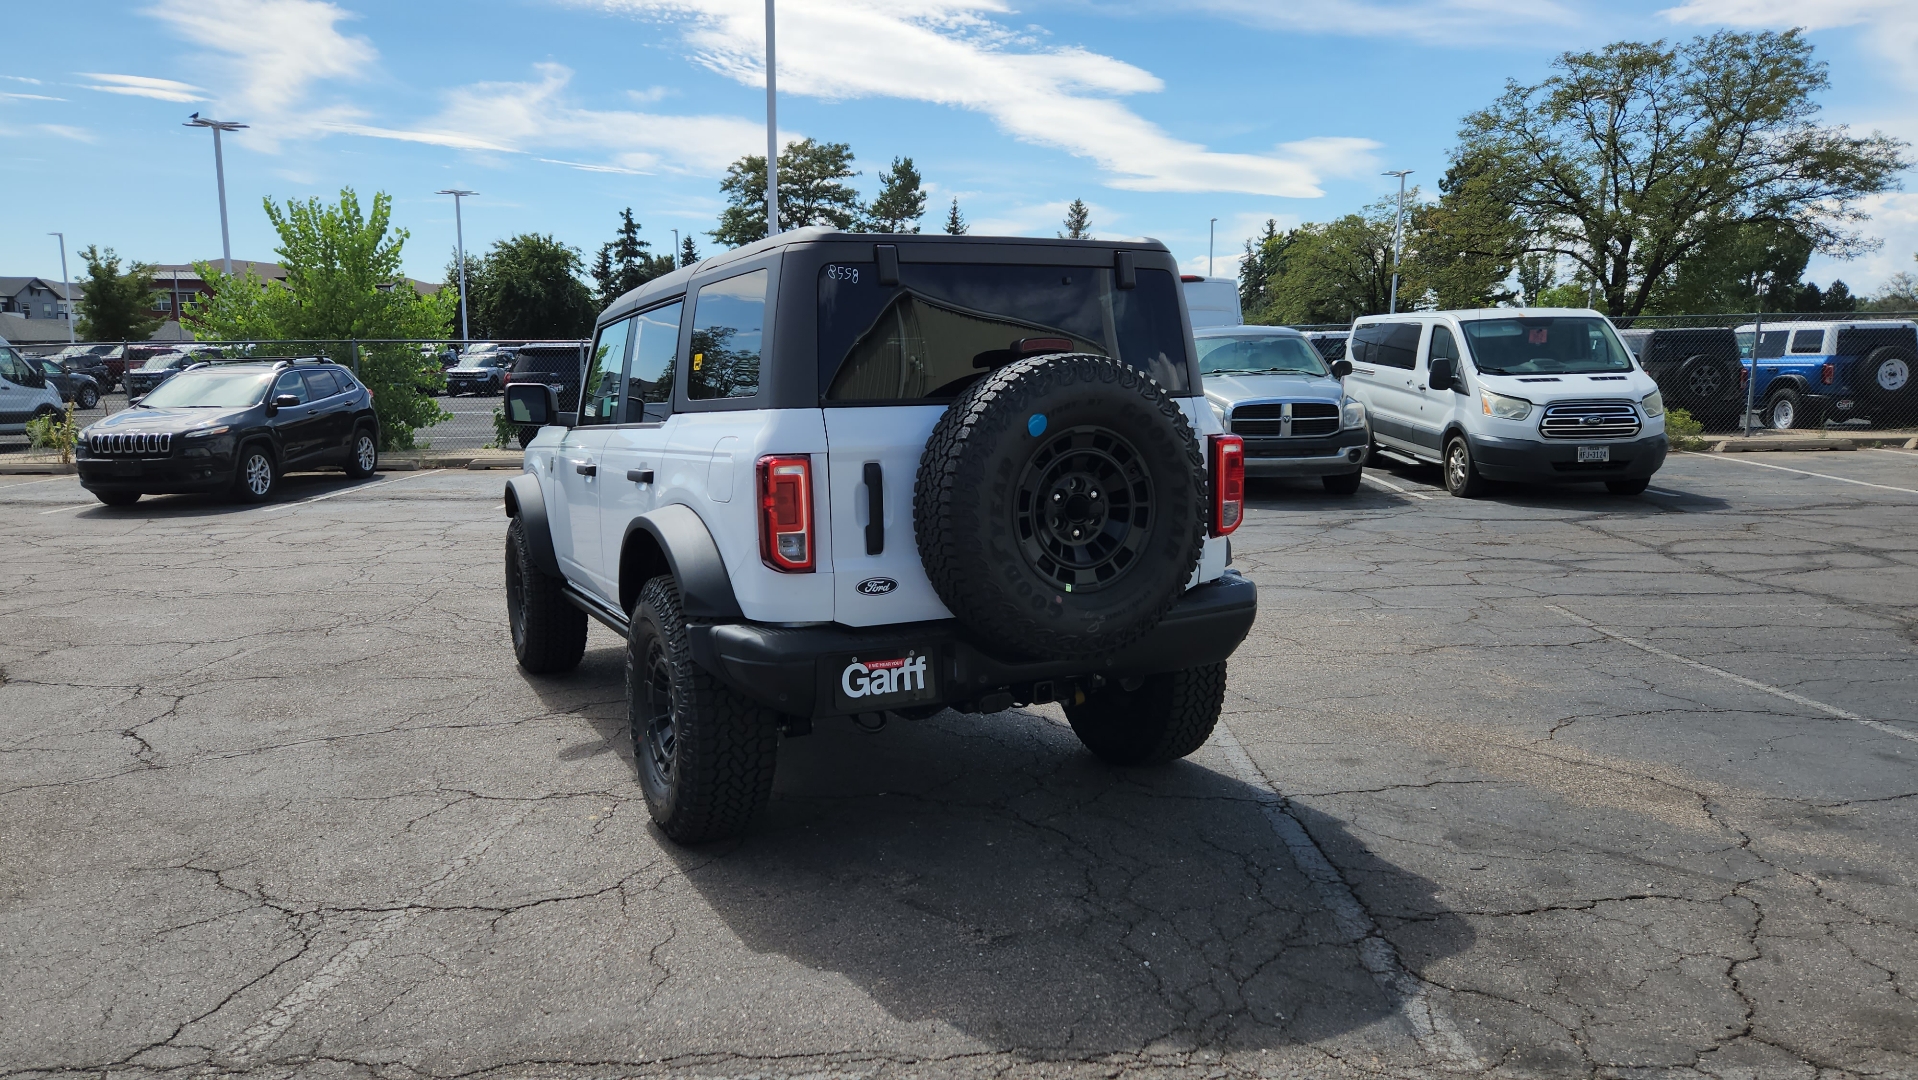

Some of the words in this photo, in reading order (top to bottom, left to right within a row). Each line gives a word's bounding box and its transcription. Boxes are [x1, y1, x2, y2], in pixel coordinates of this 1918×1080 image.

[827, 264, 859, 284] 8558
[864, 580, 891, 593] Ford
[841, 655, 927, 698] Garff
